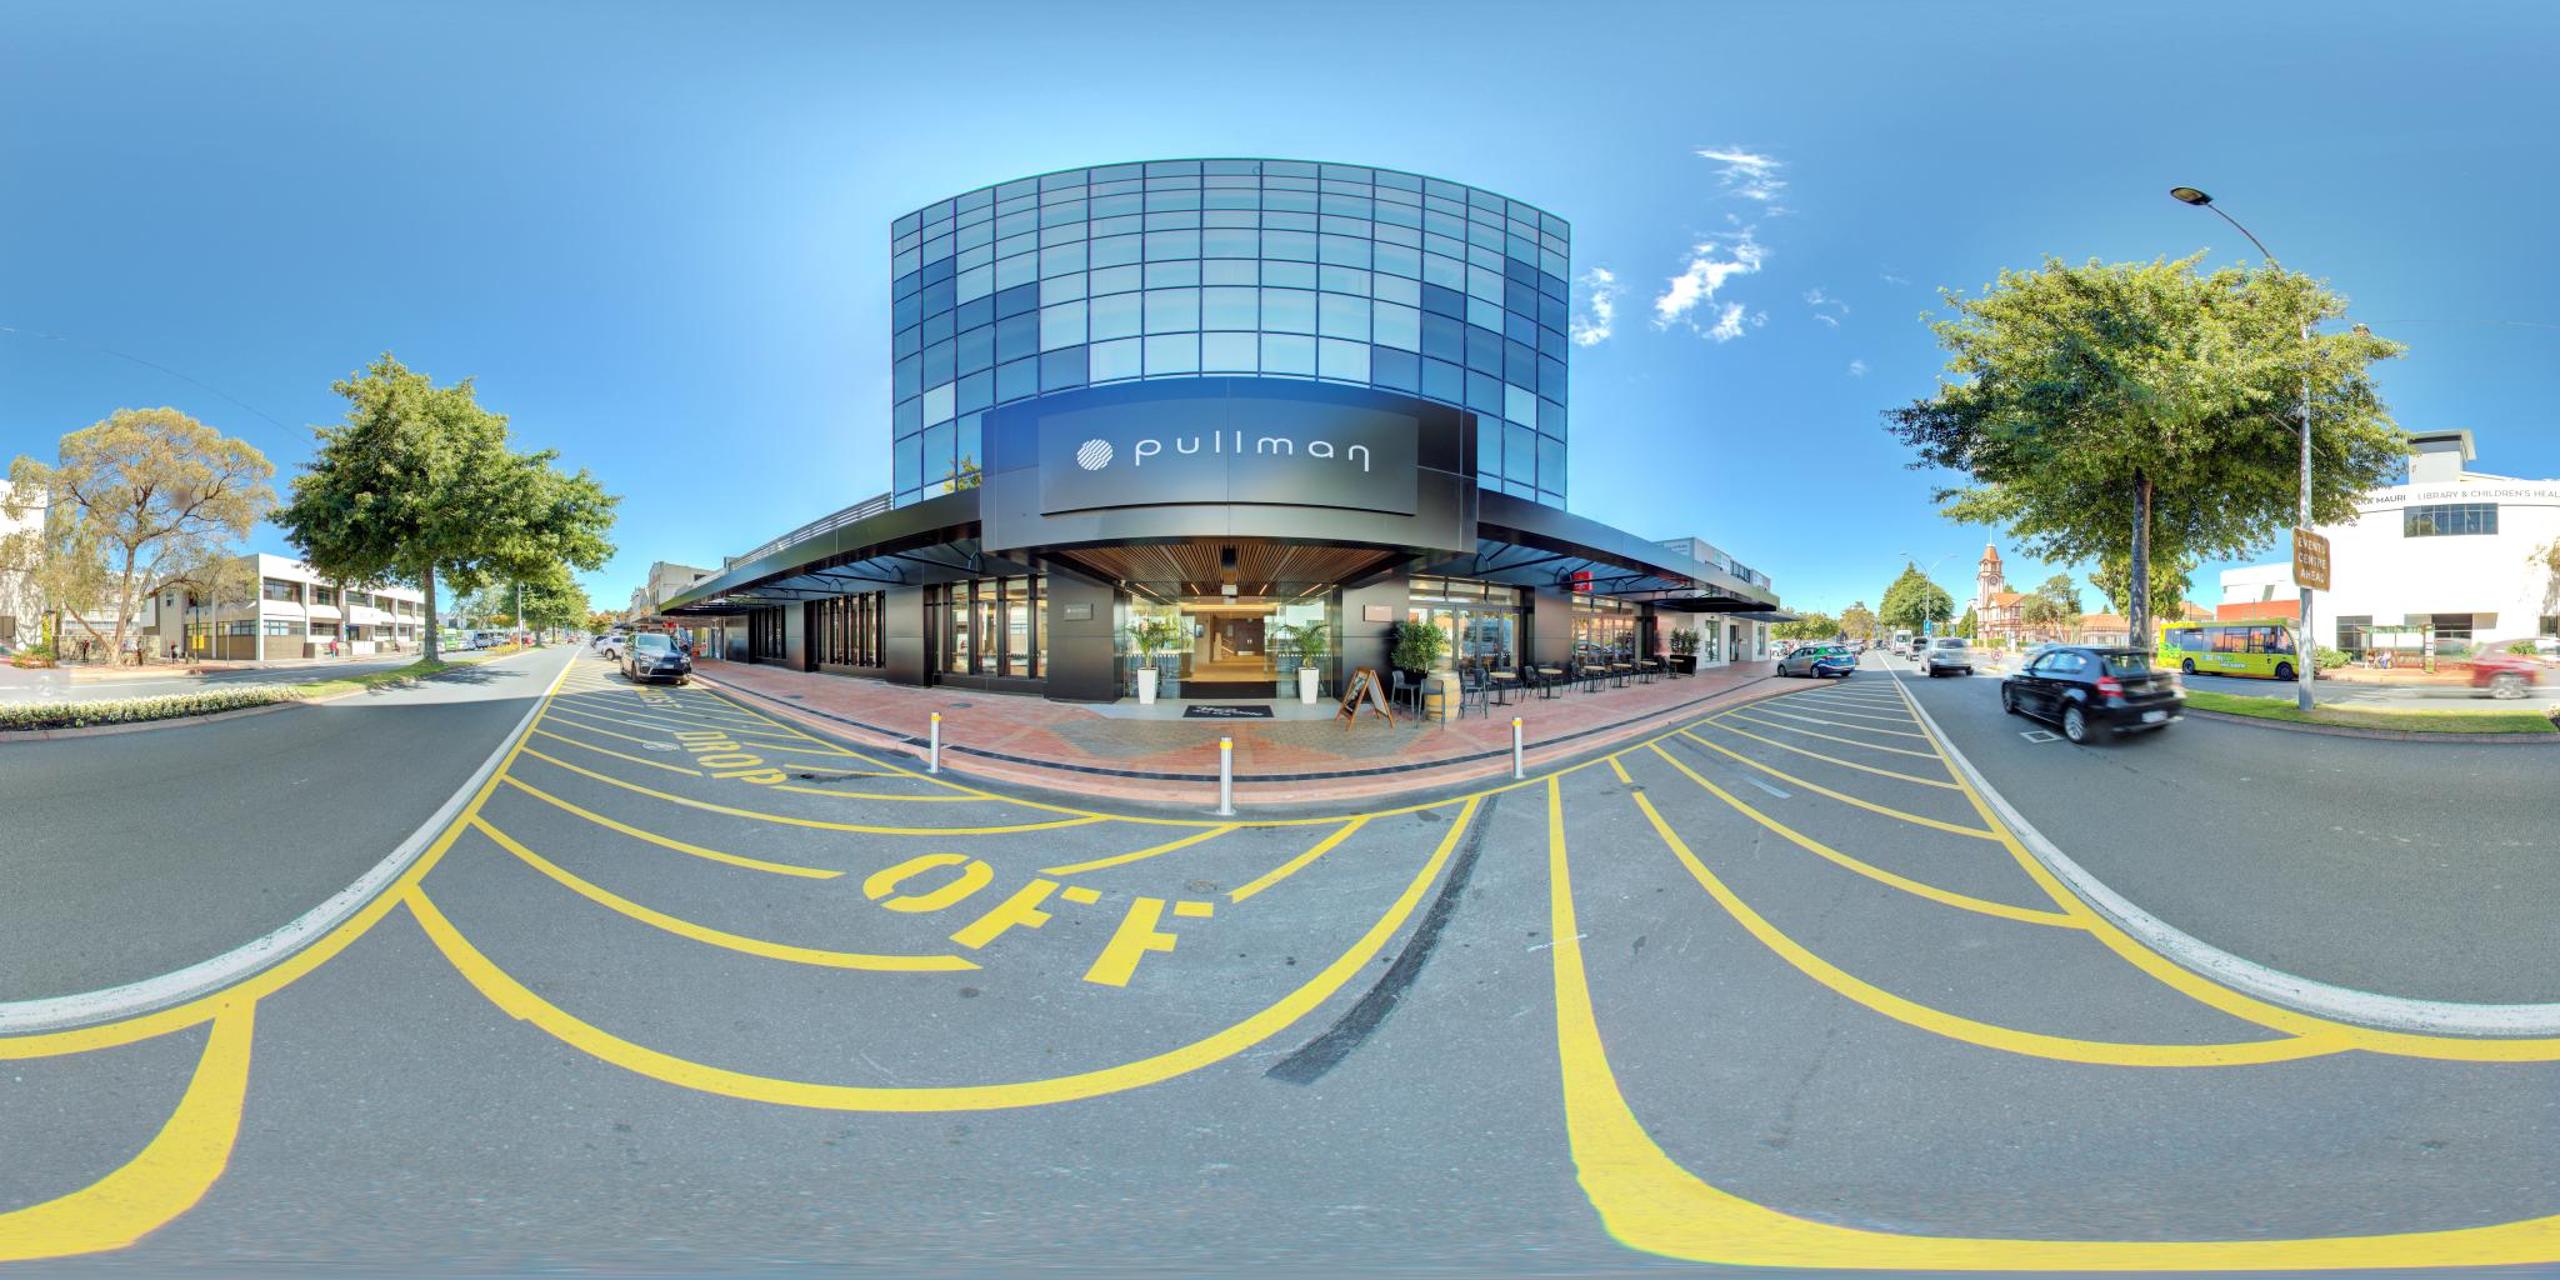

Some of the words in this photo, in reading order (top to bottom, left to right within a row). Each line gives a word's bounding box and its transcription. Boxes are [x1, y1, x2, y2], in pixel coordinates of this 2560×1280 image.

[1136, 430, 1369, 472] pullman
[2376, 493, 2406, 504] MAURI
[2417, 490, 2458, 500] LIBRARY
[2461, 490, 2468, 498] &
[2298, 552, 2326, 569] CENTRE
[2301, 568, 2325, 583] AHEAD
[673, 731, 787, 784] DROP
[862, 853, 1214, 987] OFF
